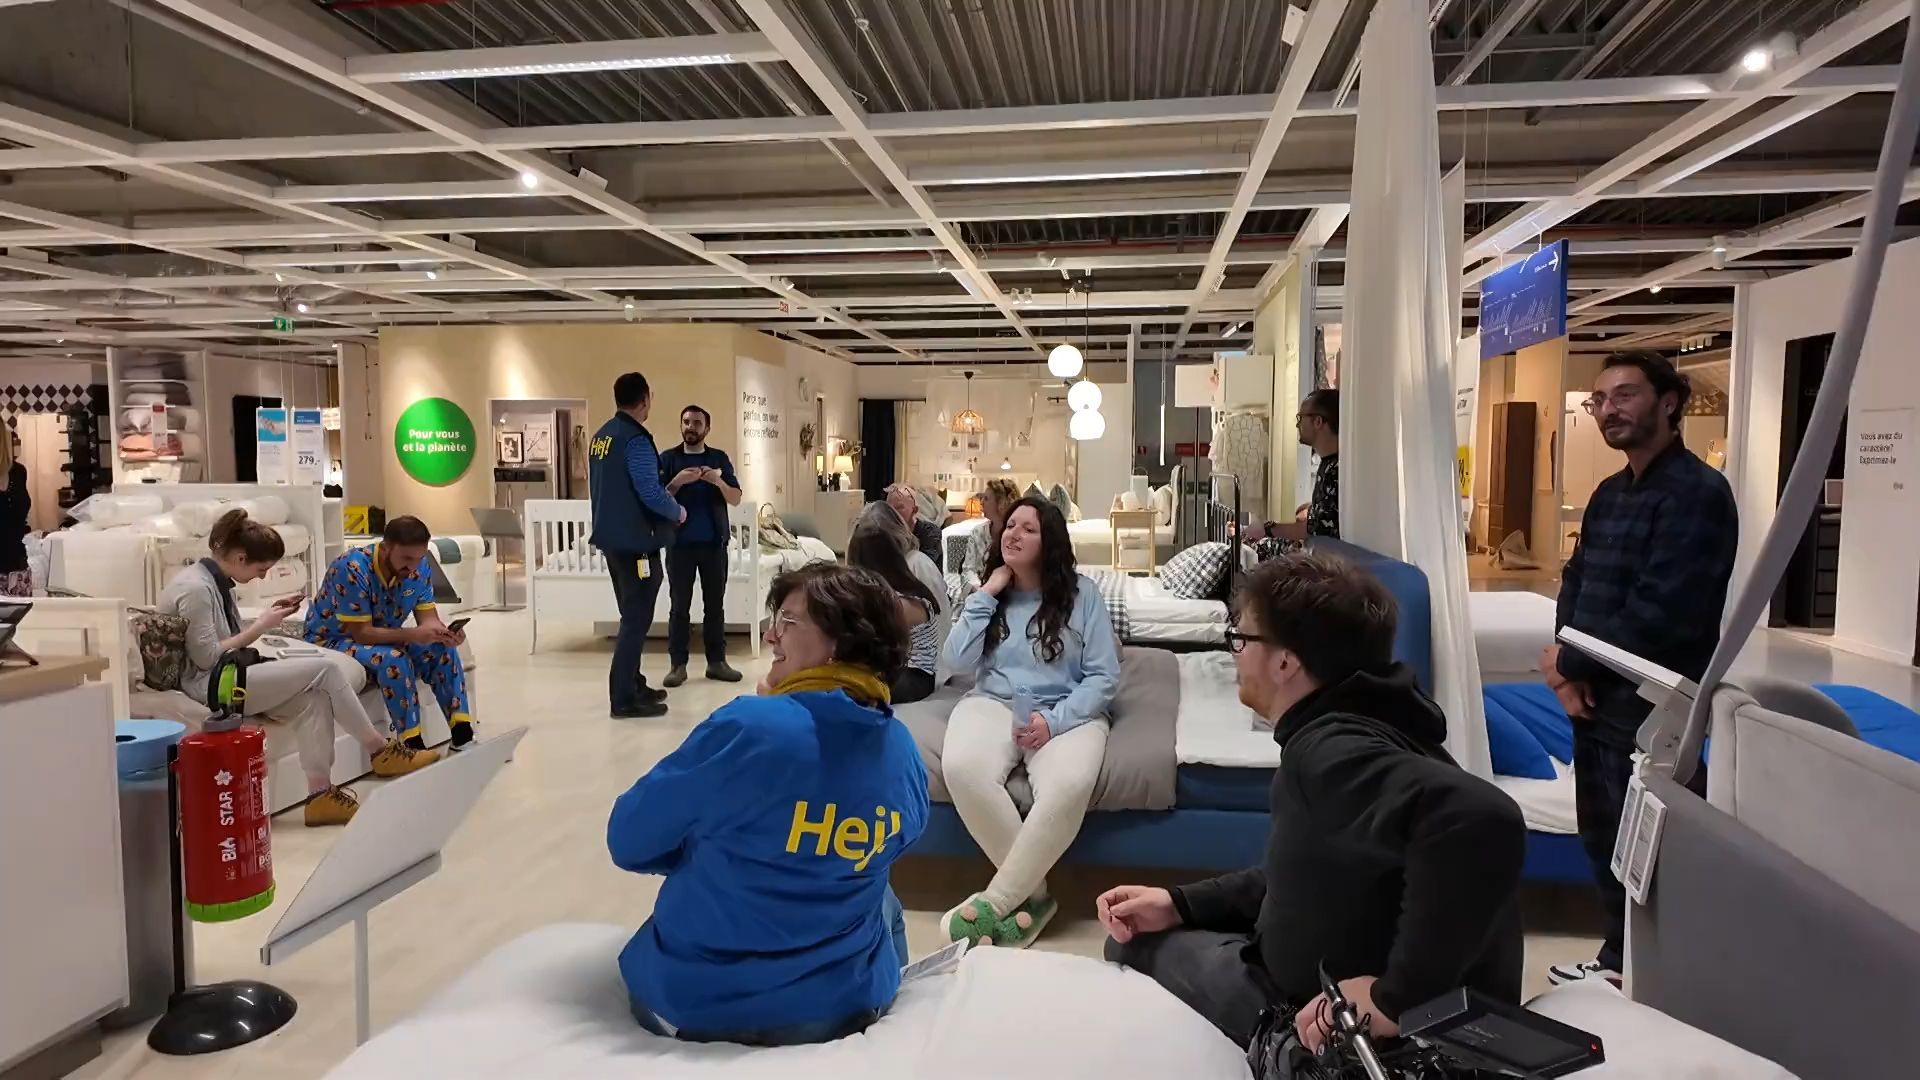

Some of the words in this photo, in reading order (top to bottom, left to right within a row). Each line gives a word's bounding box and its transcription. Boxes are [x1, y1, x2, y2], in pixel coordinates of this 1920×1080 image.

[408, 428, 434, 439] Pour
[435, 430, 460, 439] vous
[1860, 432, 1876, 441] Vous
[1893, 432, 1903, 440] du
[402, 442, 414, 452] et
[415, 442, 425, 452] la
[427, 442, 467, 455] planète
[590, 436, 612, 460] Hej!
[218, 791, 235, 826] STAR
[785, 801, 900, 872] Hej!
